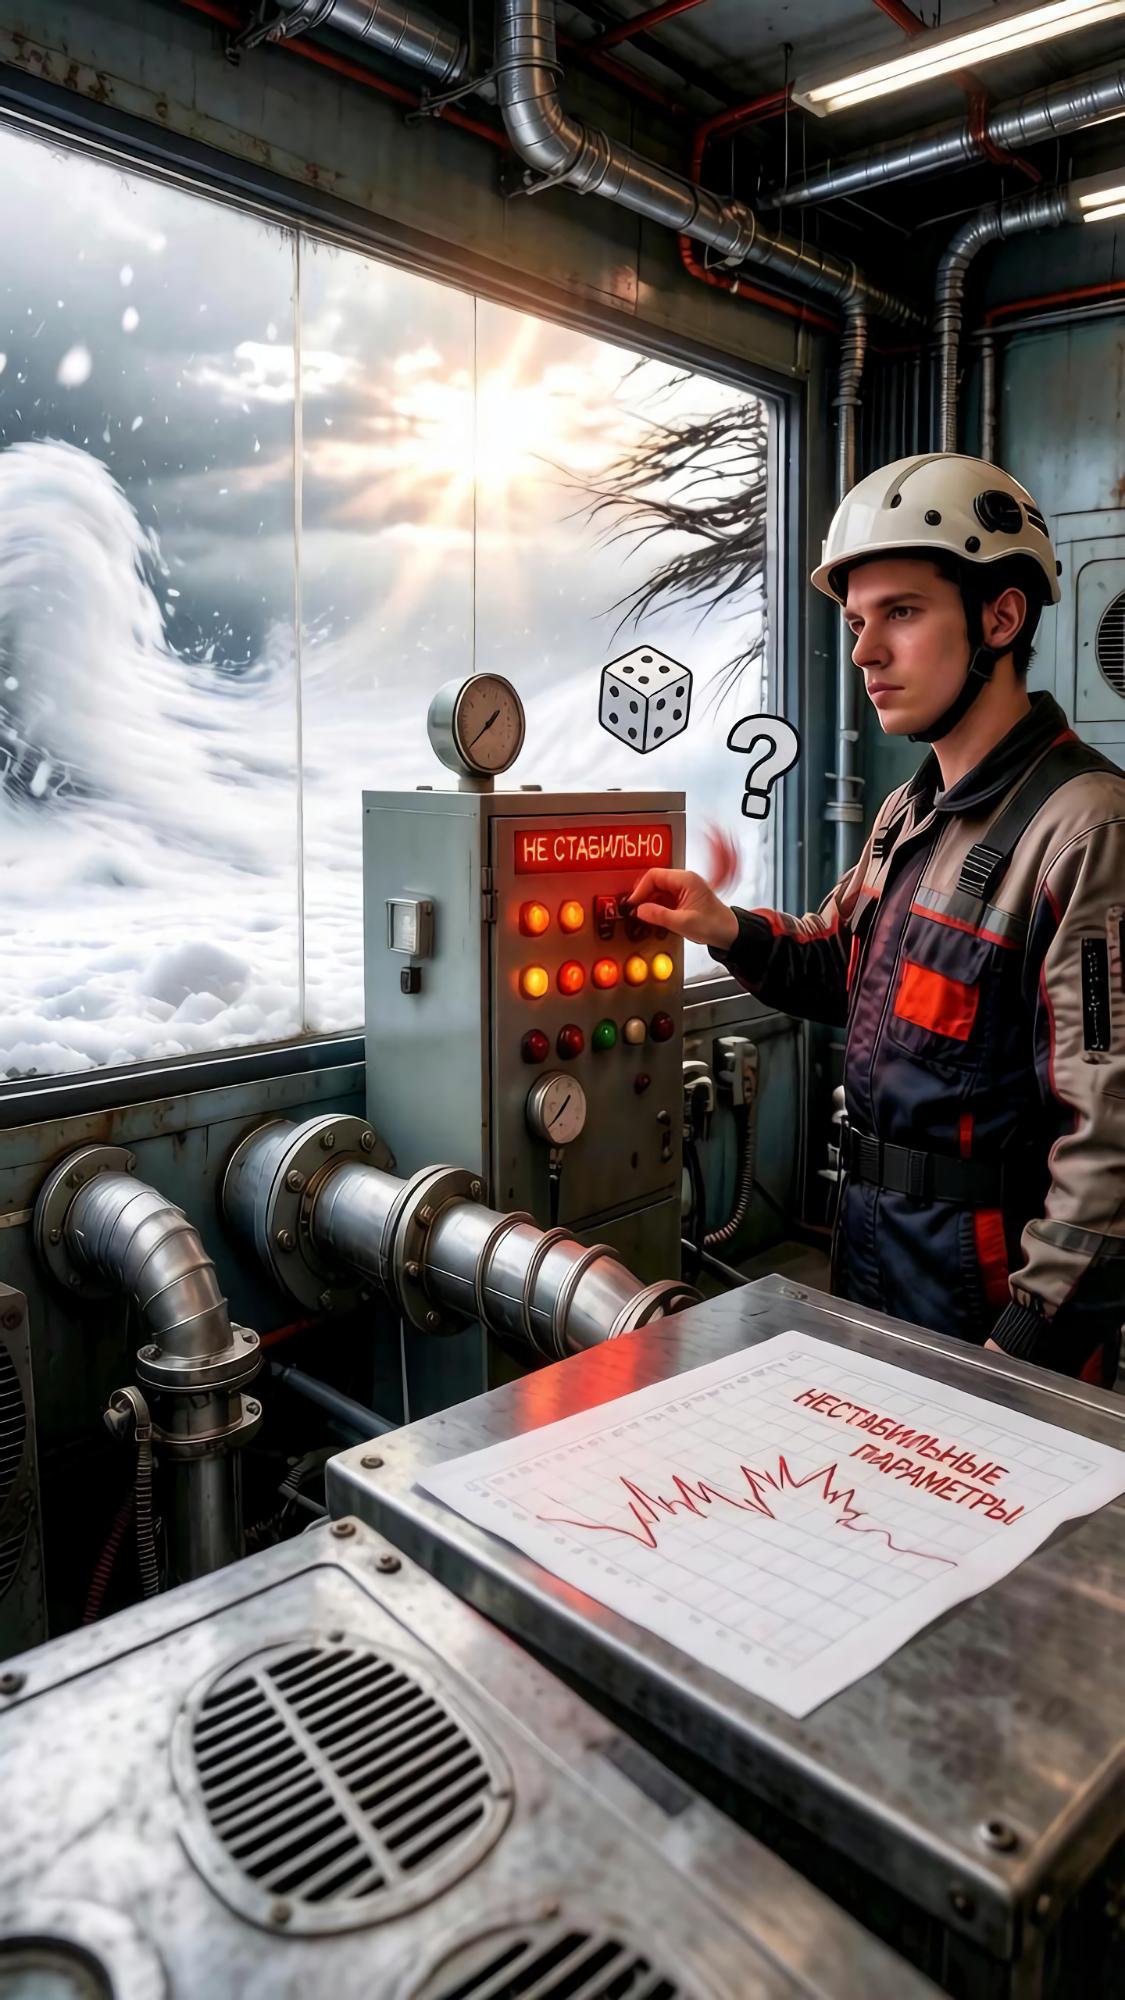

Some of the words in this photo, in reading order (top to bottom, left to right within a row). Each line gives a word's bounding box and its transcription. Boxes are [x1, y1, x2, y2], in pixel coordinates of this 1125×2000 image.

[523, 837, 548, 862] НЕ
[553, 833, 663, 862] СТАБИЛЬНО
[793, 1388, 1010, 1486] НЕСТАБИЛЬНЫЕ
[849, 1443, 1025, 1526] ПАРАМЕТРЫ
